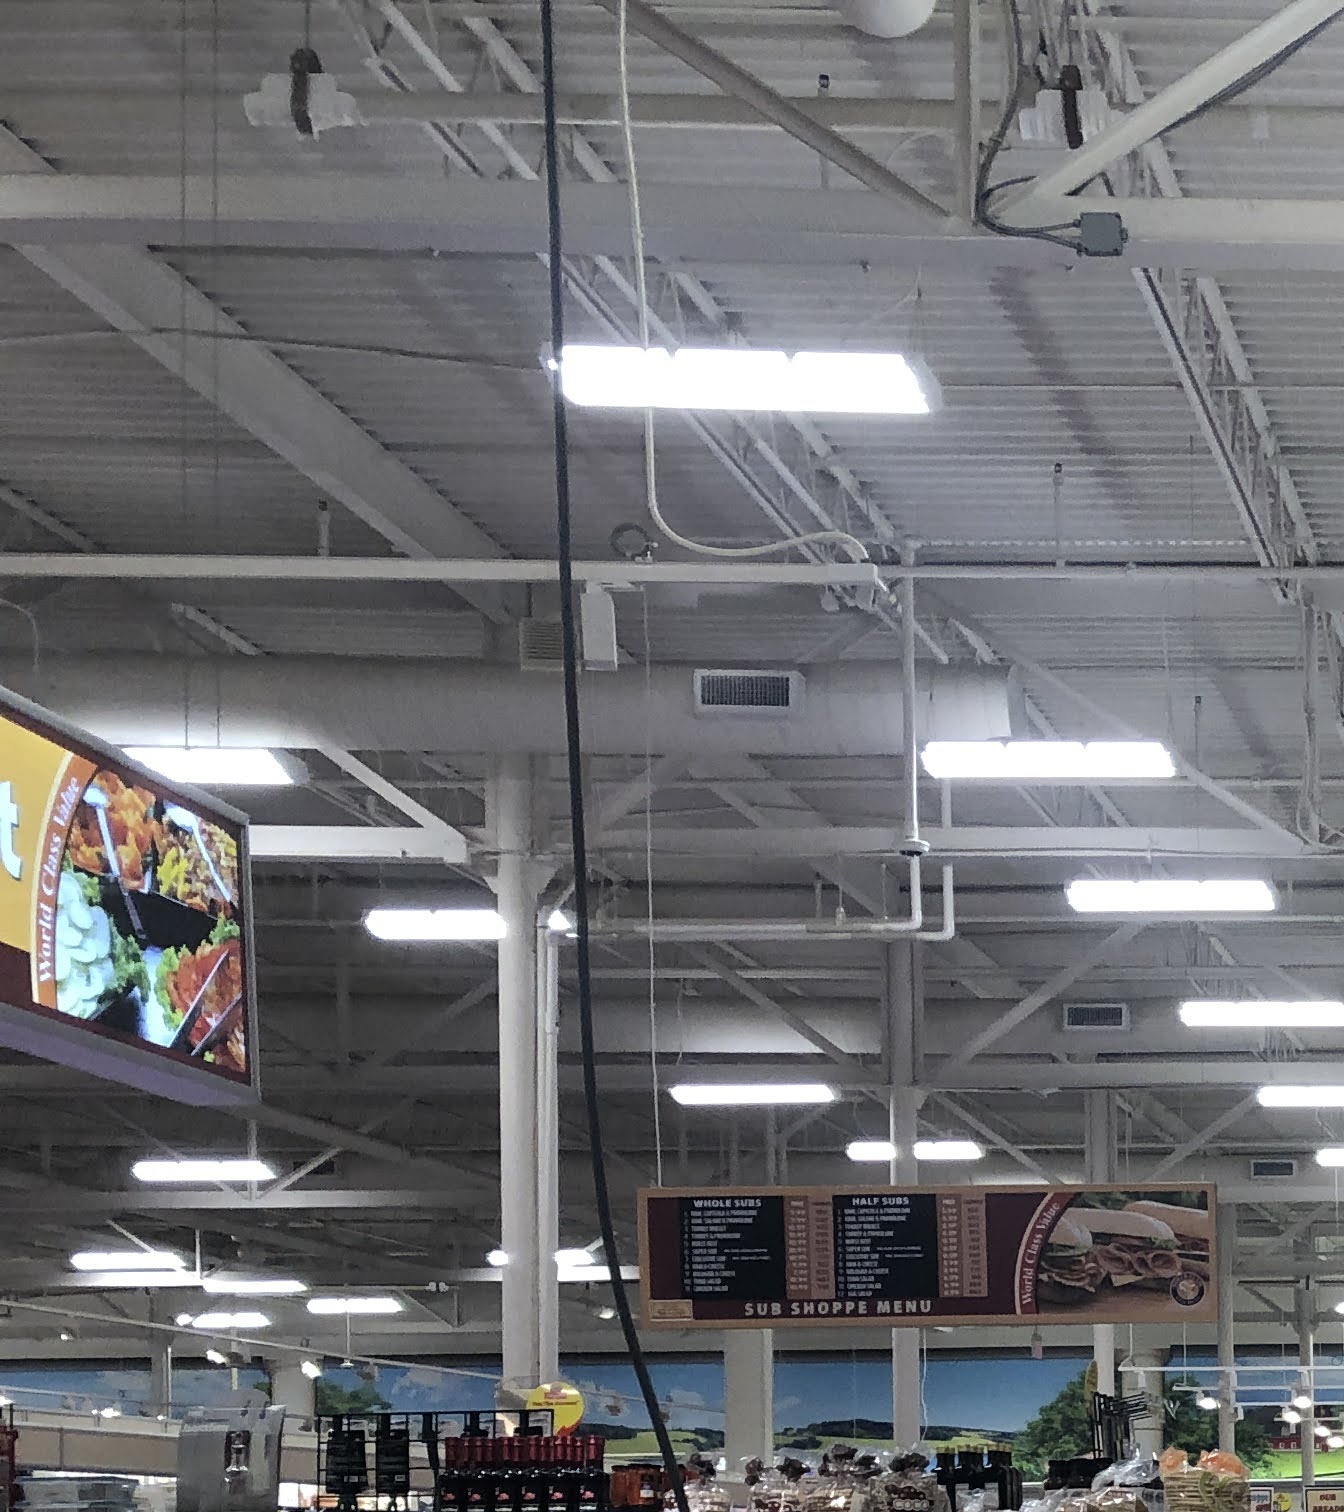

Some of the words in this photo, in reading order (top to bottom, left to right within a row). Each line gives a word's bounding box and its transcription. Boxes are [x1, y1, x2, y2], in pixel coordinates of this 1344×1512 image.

[41, 832, 62, 896] Class
[39, 903, 54, 982] World
[693, 1199, 732, 1208] WHOLE
[734, 1198, 762, 1208] SUBS
[852, 1197, 879, 1206] HALF
[882, 1197, 910, 1205] SUBS
[744, 1302, 782, 1316] SUB
[791, 1301, 868, 1315] SHOPPE
[876, 1300, 932, 1314] MENU
